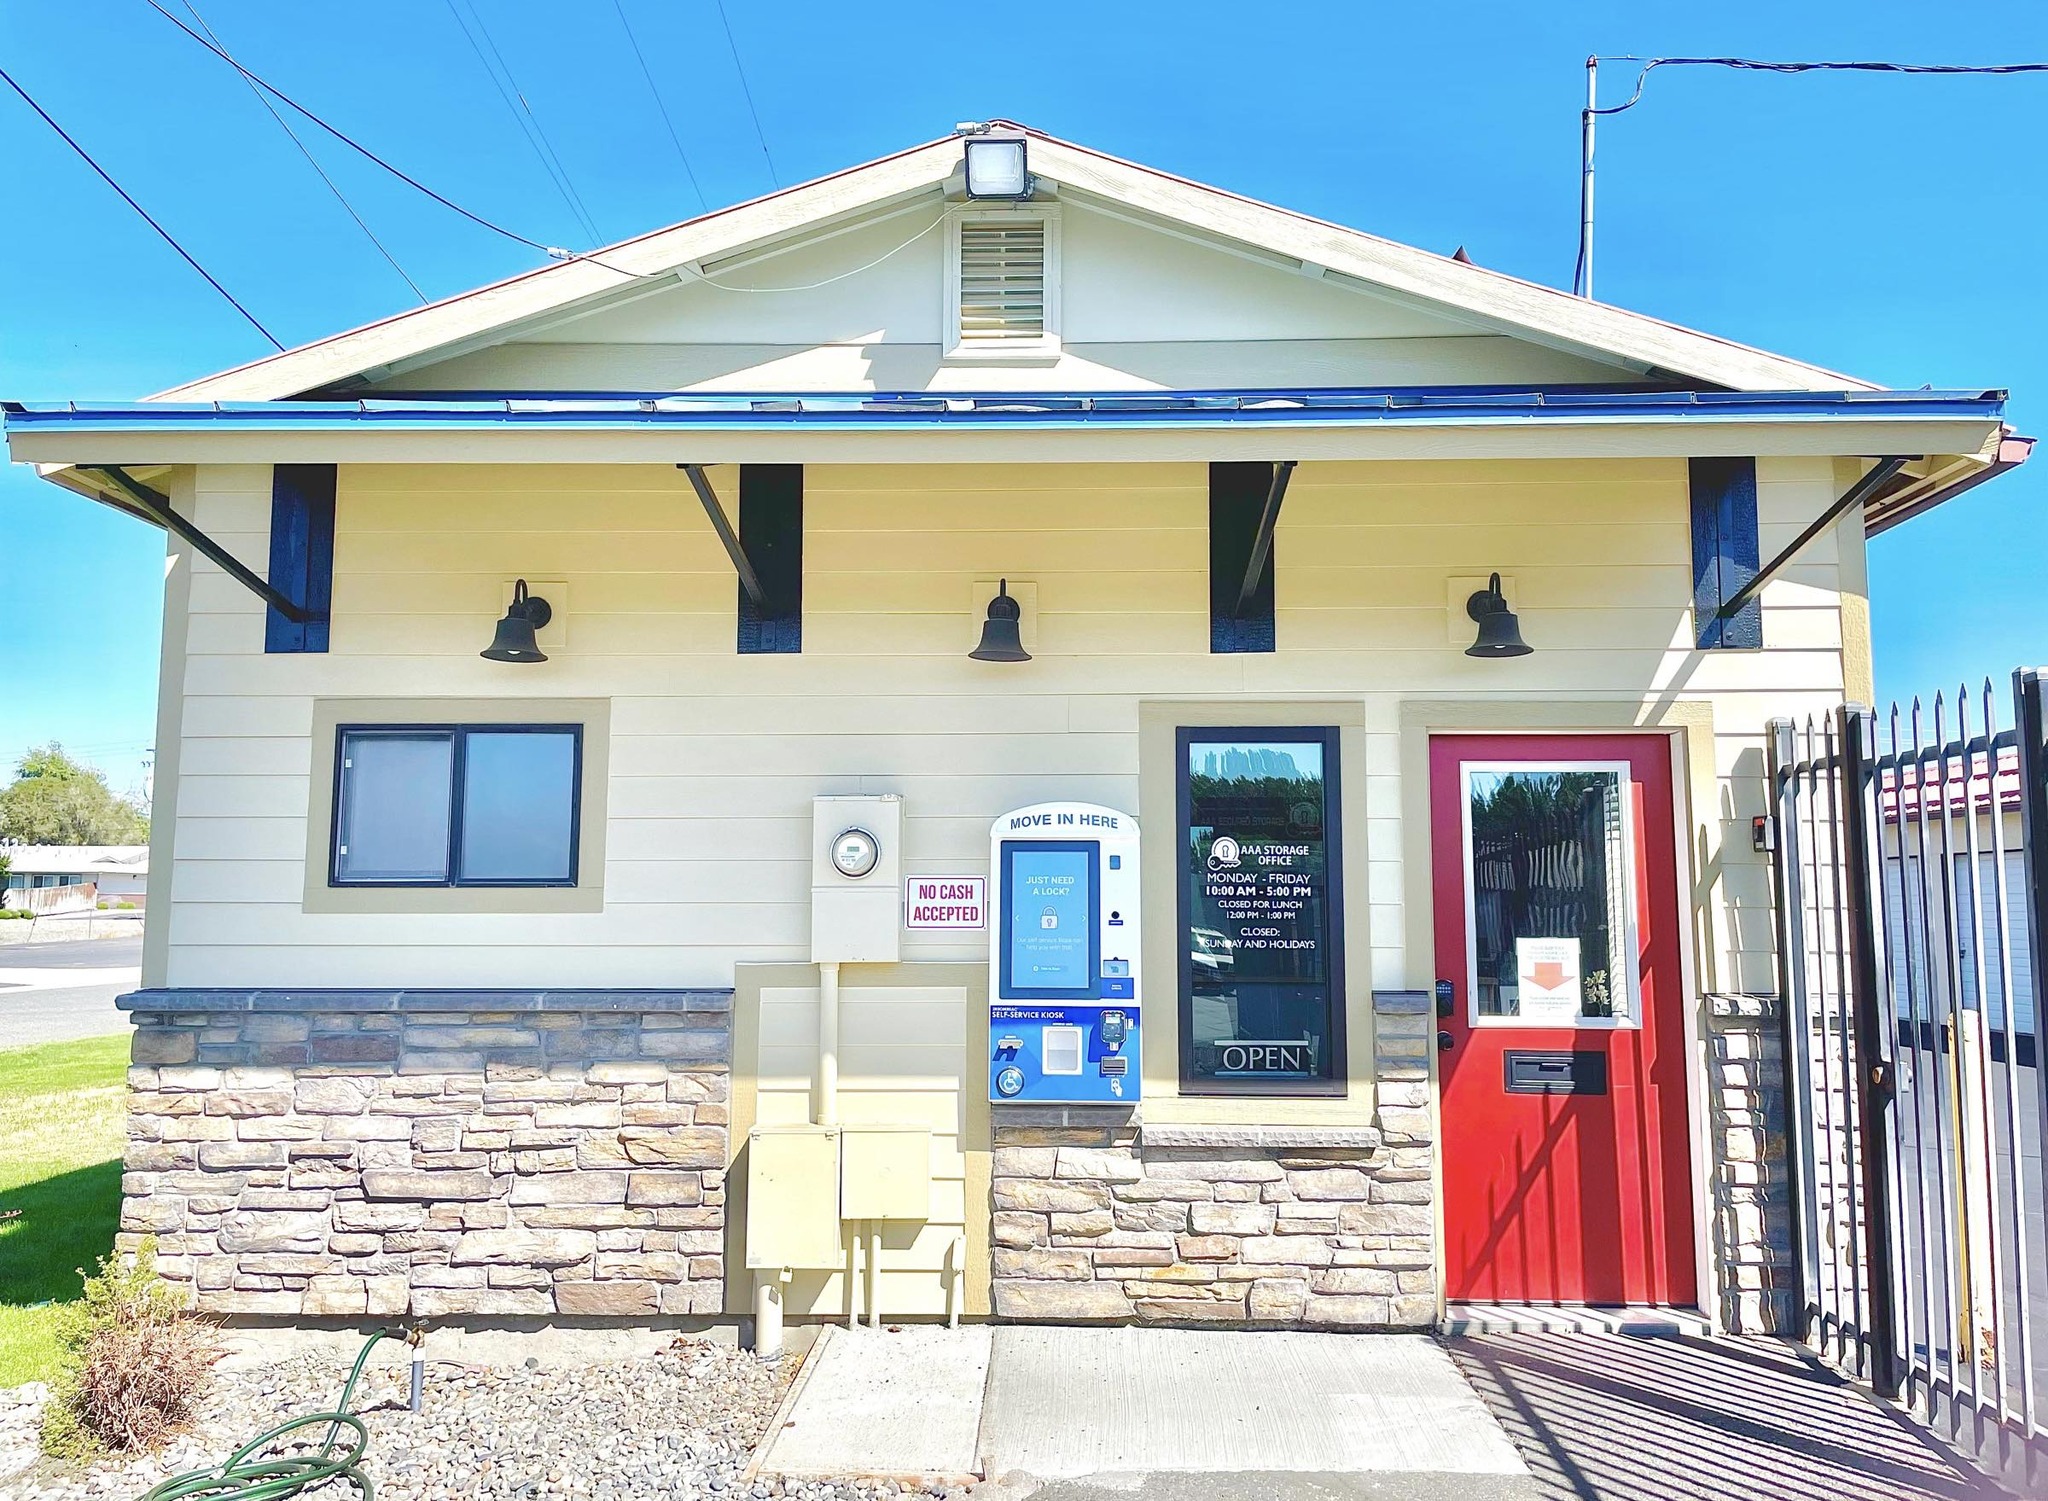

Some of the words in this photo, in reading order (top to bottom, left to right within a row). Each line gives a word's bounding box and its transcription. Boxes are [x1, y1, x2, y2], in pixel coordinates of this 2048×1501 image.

[1010, 814, 1051, 830] MOVE
[1058, 814, 1073, 824] IN
[1080, 814, 1118, 829] HERE
[1241, 846, 1261, 855] AAA
[1264, 846, 1309, 855] STORAGE
[1259, 856, 1292, 865] OFFICE
[1208, 873, 1258, 883] MONDAY
[1269, 874, 1311, 884] FRIDAY
[919, 885, 936, 899] NO
[940, 885, 973, 899] CASH
[1206, 886, 1234, 895] 10:00
[1236, 887, 1256, 896] AM
[1266, 887, 1290, 896] 5:00
[1293, 887, 1311, 896] PM
[914, 906, 978, 921] ACCEPTED
[1240, 928, 1280, 936] CLOSED:
[1245, 940, 1267, 948] AND
[1269, 940, 1315, 949] HOLIDAYS
[1223, 1047, 1300, 1070] OPEN
